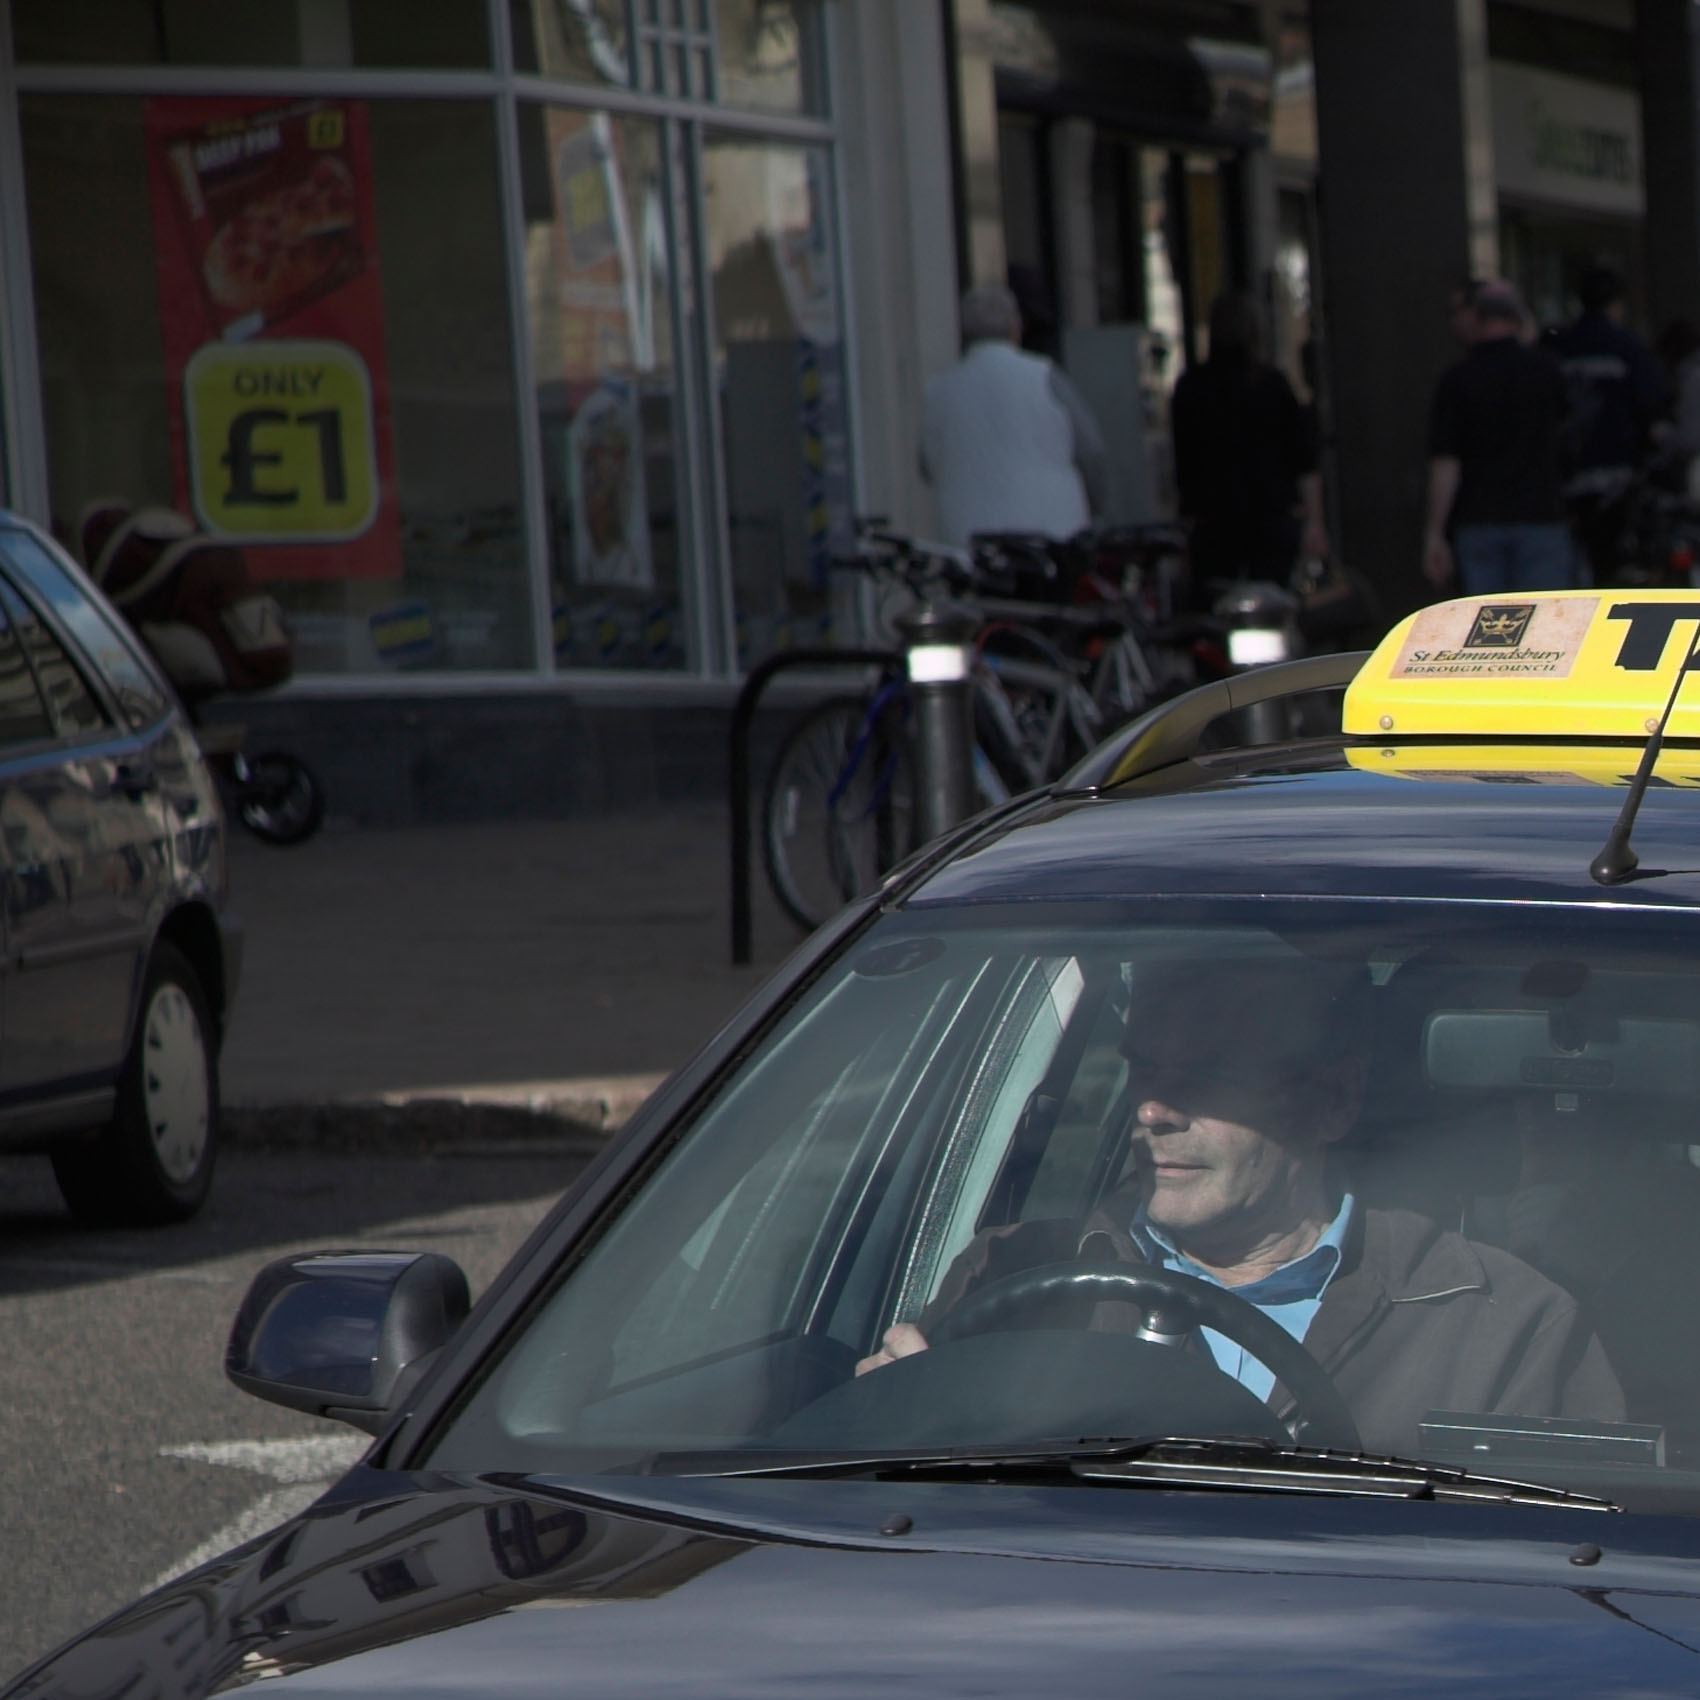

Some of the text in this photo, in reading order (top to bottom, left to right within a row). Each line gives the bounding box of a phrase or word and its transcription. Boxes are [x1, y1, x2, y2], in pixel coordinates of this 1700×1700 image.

[234, 366, 324, 397] ONLY
[221, 408, 348, 507] £1
[1409, 648, 1566, 664] St Edmundsbury
[1404, 664, 1557, 674] BOROUGH COUNCIL
